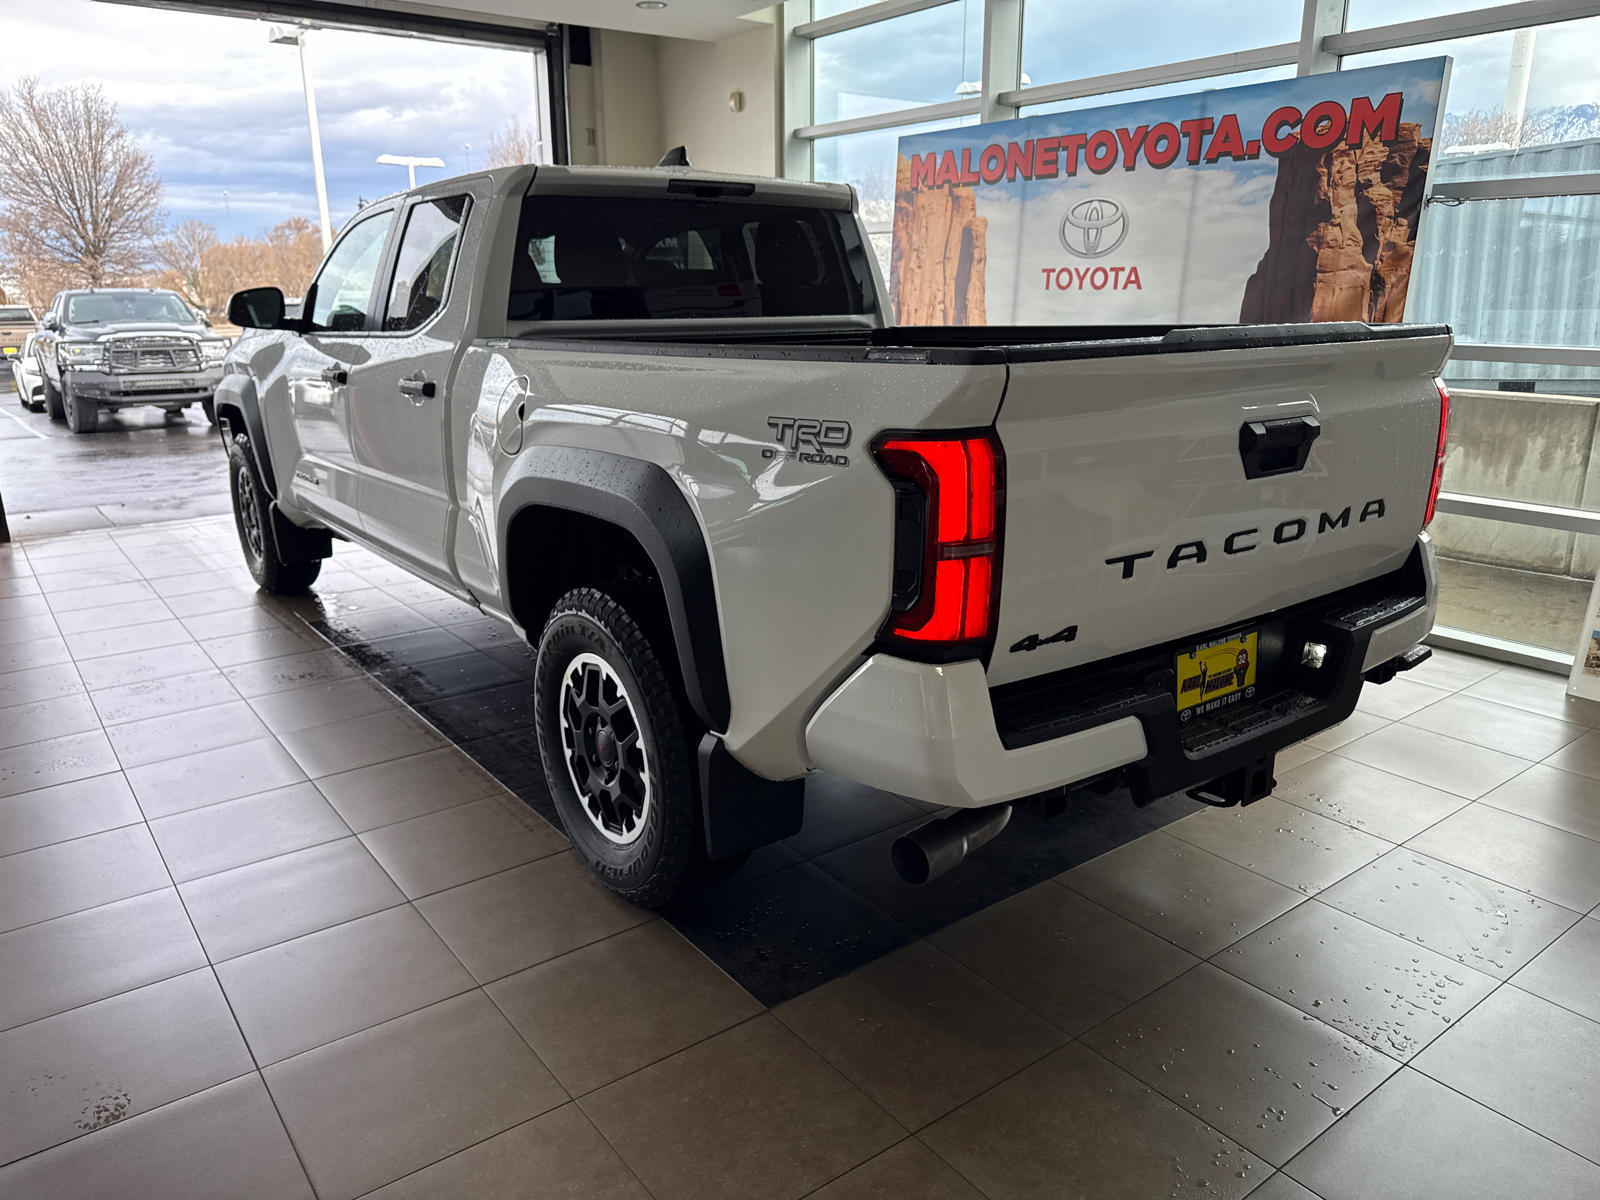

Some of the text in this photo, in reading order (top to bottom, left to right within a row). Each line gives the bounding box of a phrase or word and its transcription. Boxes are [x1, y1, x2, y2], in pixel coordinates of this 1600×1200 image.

[911, 92, 1404, 189] MALONETOYOTA.COM
[1041, 266, 1143, 291] TOYOTA
[767, 416, 853, 455] TRD
[798, 452, 850, 467] ROAD
[1104, 498, 1386, 580] TACOMA
[1196, 632, 1242, 651] KARL MALONE TOYOTA
[1238, 653, 1246, 664] 32
[1196, 692, 1241, 715] WE MAKE IT EASY
